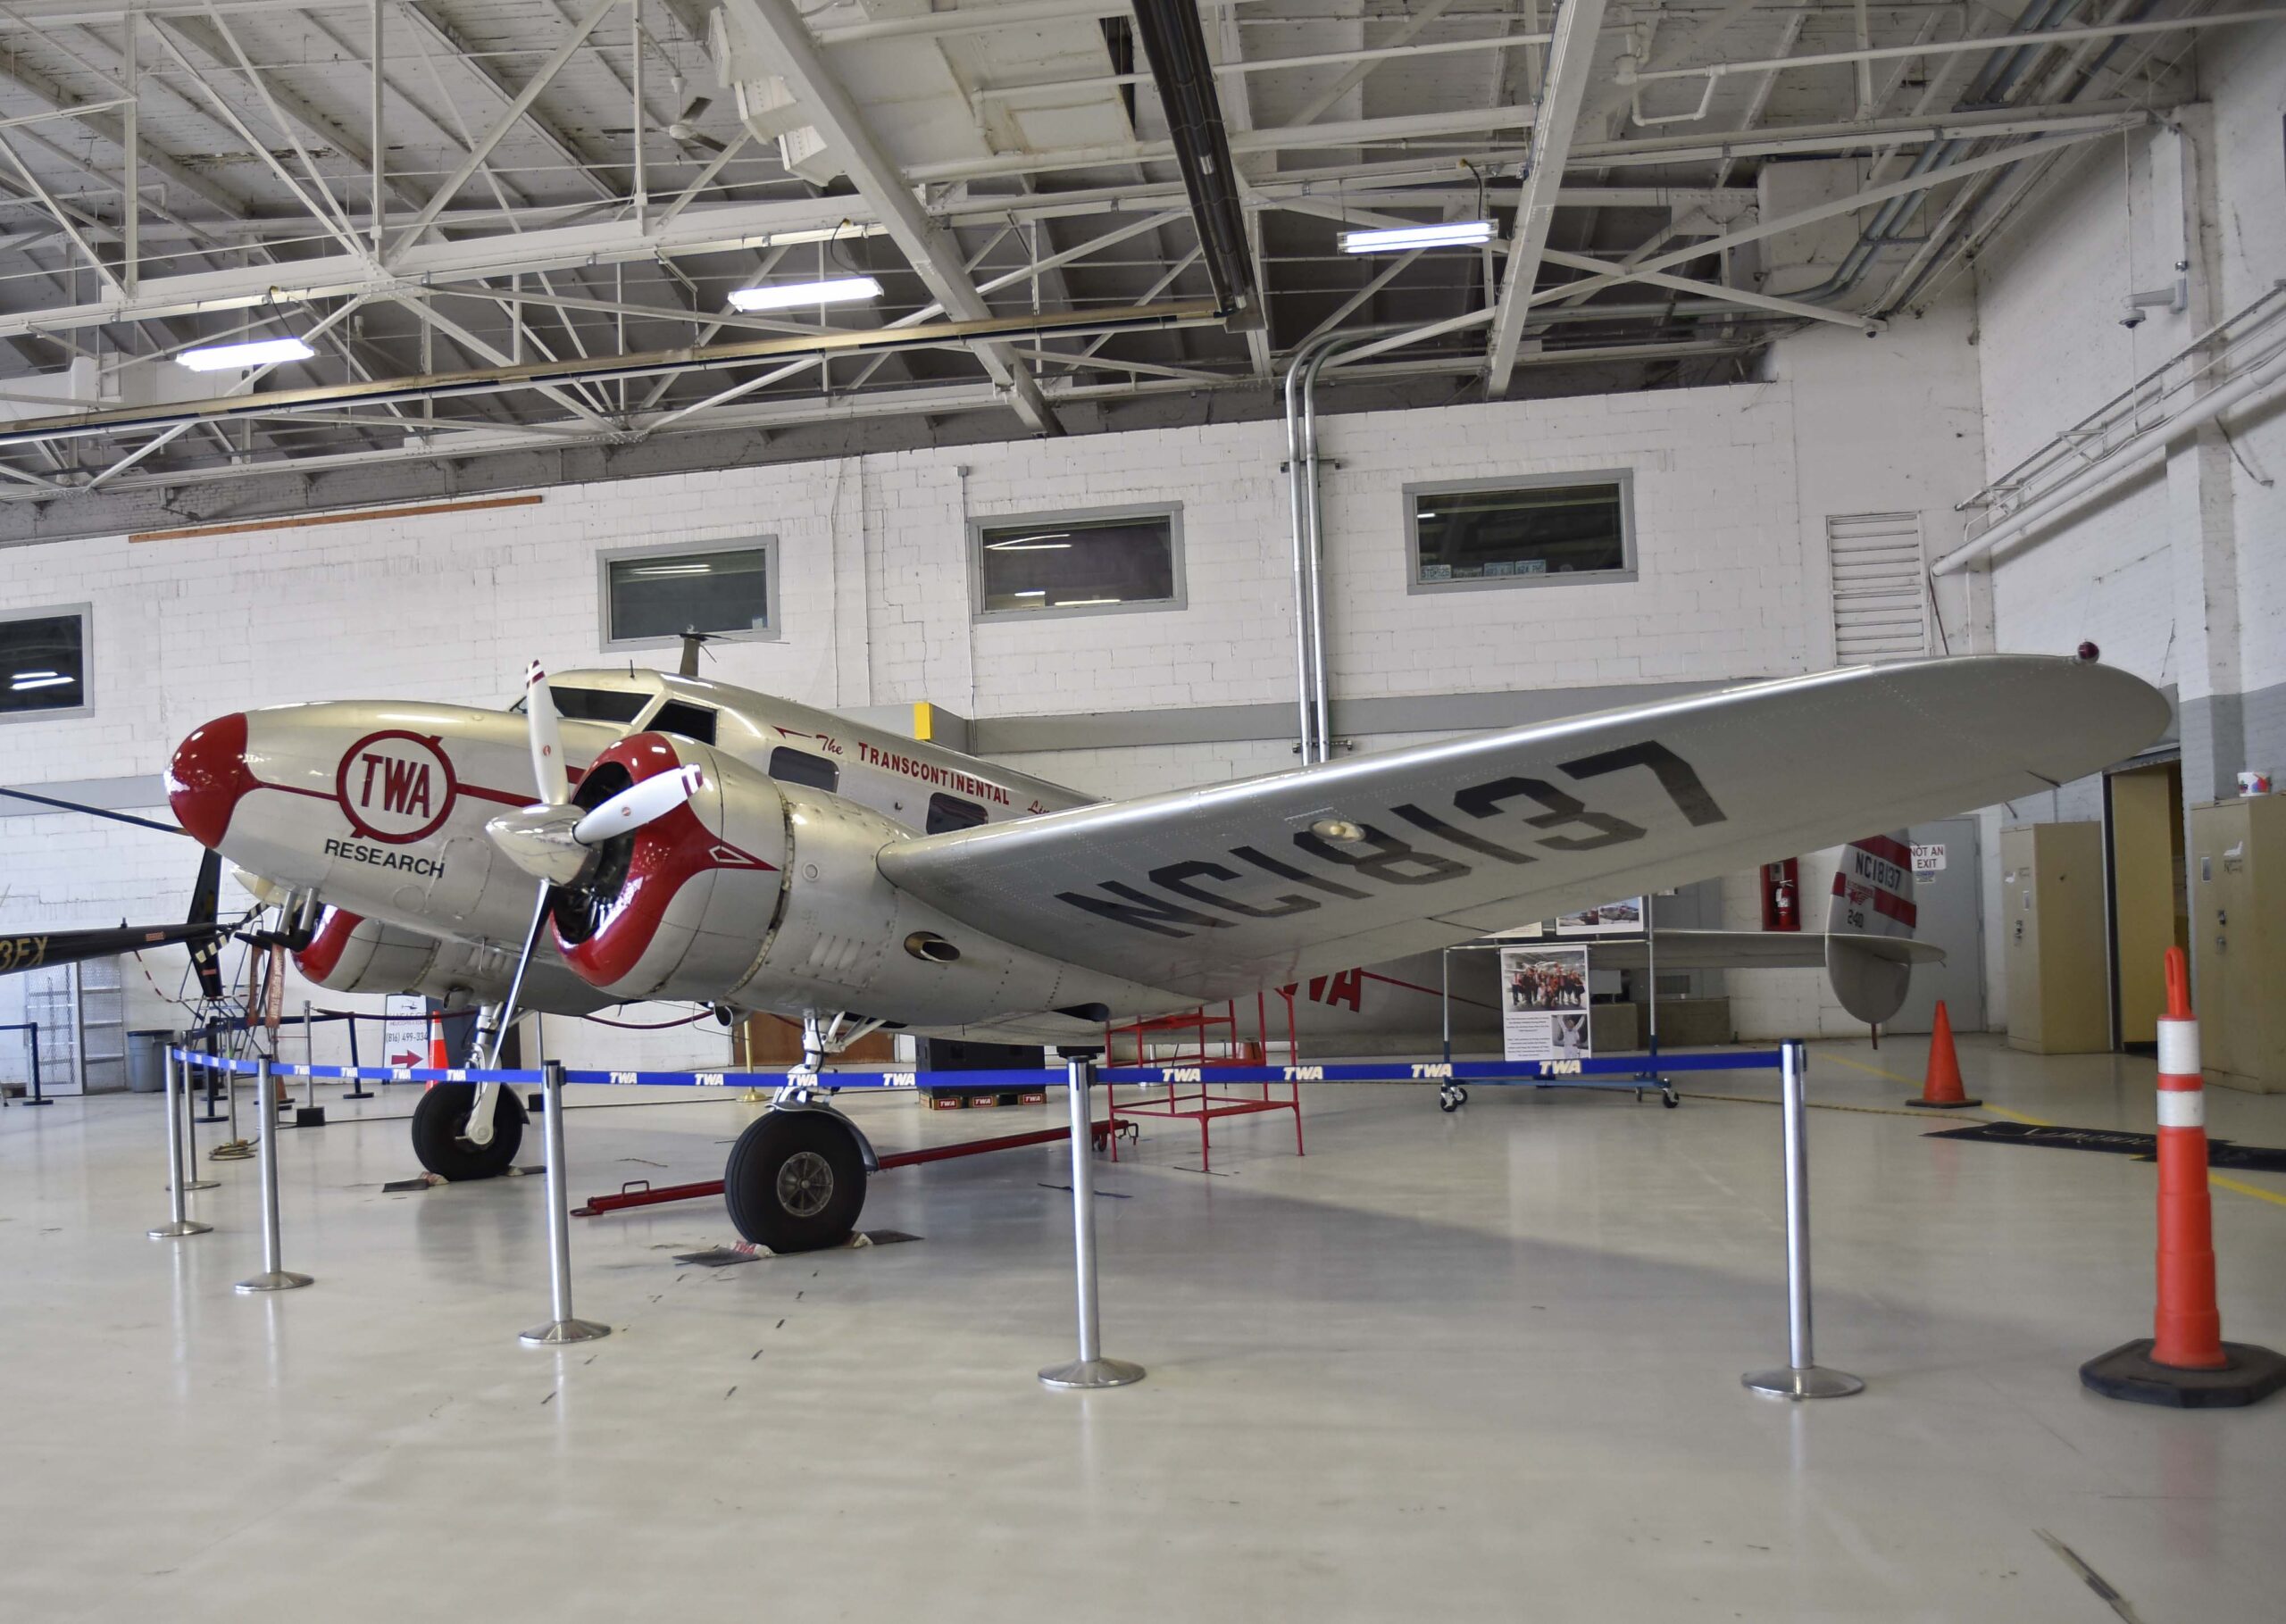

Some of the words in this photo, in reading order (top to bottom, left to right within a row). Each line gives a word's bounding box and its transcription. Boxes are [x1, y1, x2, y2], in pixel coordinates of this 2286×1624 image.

[815, 734, 844, 755] The
[858, 742, 1011, 806] TRANSCONTINENTAL
[361, 753, 430, 819] TWA
[1055, 740, 1727, 938] NC18137
[324, 838, 445, 879] RESEARCH
[1911, 847, 1928, 857] NOT
[1931, 846, 1944, 856] AN
[1855, 852, 1901, 890] NC18137
[1917, 859, 1937, 869] EXIT
[392, 1069, 411, 1079] TWA
[1283, 1066, 1323, 1080] TWA
[1411, 1063, 1452, 1078] TWA
[1539, 1060, 1581, 1075] TWA
[446, 1070, 466, 1080] TWA
[610, 1072, 638, 1085] TWA
[695, 1073, 724, 1086] TWA
[788, 1073, 818, 1087] TWA
[883, 1072, 915, 1086] TWA
[1162, 1069, 1201, 1082] TWA
